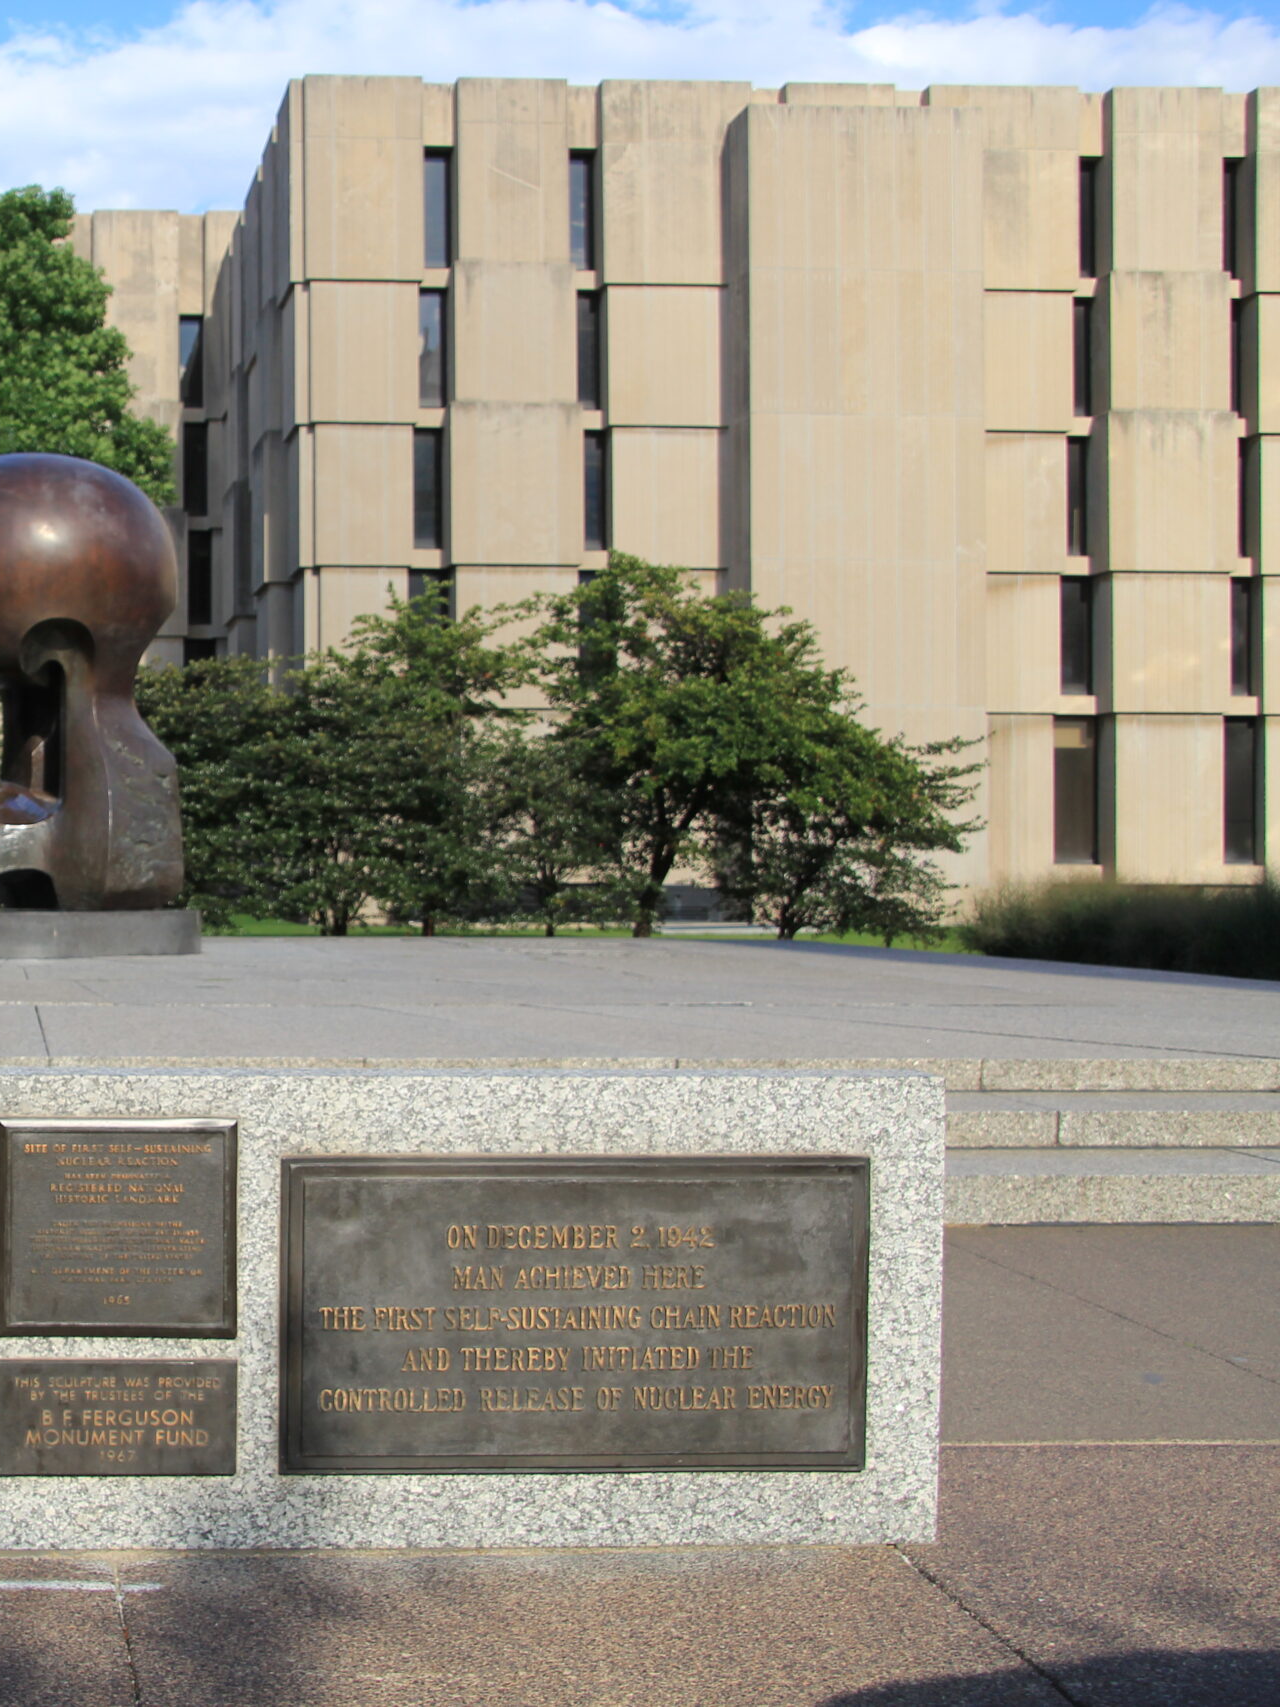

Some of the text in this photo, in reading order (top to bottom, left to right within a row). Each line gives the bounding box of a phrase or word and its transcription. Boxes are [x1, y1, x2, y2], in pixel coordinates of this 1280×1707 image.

[23, 1143, 48, 1154] SITE
[52, 1143, 67, 1153] OF
[71, 1143, 104, 1153] FIRST
[56, 1156, 180, 1167] NUCLEAR REACTION
[50, 1183, 186, 1193] REGSTERED NAONAL
[54, 1194, 109, 1204] HISTORIC
[447, 1224, 478, 1249] ON
[486, 1224, 618, 1250] DECEMBER
[658, 1225, 716, 1250] 1942
[155, 1267, 204, 1277] INTEROR
[452, 1265, 706, 1290] MAN ACHIEVED HERE
[319, 1303, 836, 1331] THE FIRST SELF-SUSTAINING CHAIN REACTION
[400, 1346, 754, 1372] AND THEREBY INITIATED THE
[15, 1376, 221, 1389] THIS SCULPTURE WAS PROVIDED
[30, 1390, 205, 1401] BY THE TRUSTEES OF THE
[319, 1384, 834, 1413] CONTROLLED RELEASE OF NUCLEAR ENERGY
[82, 1409, 194, 1426] FERGUSON
[25, 1429, 209, 1447] MONUMENT FUND
[99, 1450, 137, 1462] 1967
